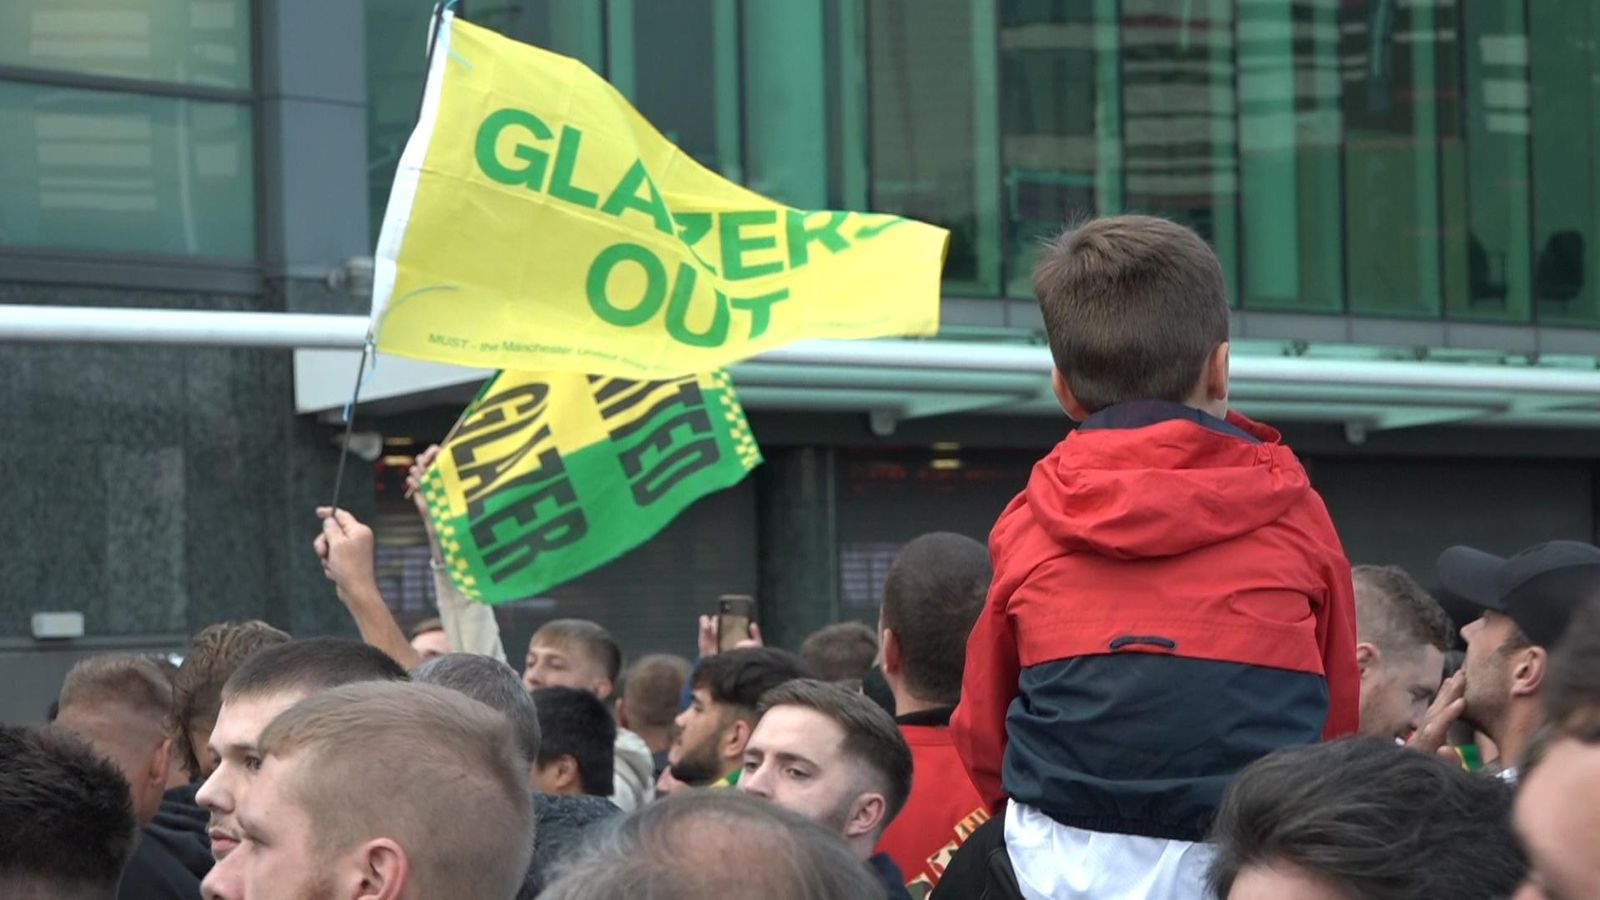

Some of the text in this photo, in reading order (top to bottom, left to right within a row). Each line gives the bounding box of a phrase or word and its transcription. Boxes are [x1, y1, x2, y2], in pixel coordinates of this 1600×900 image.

[428, 333, 469, 349] MUST
[480, 342, 499, 352] the
[502, 340, 572, 355] Manchester
[585, 243, 789, 348] OUT
[451, 383, 589, 584] GLAZER
